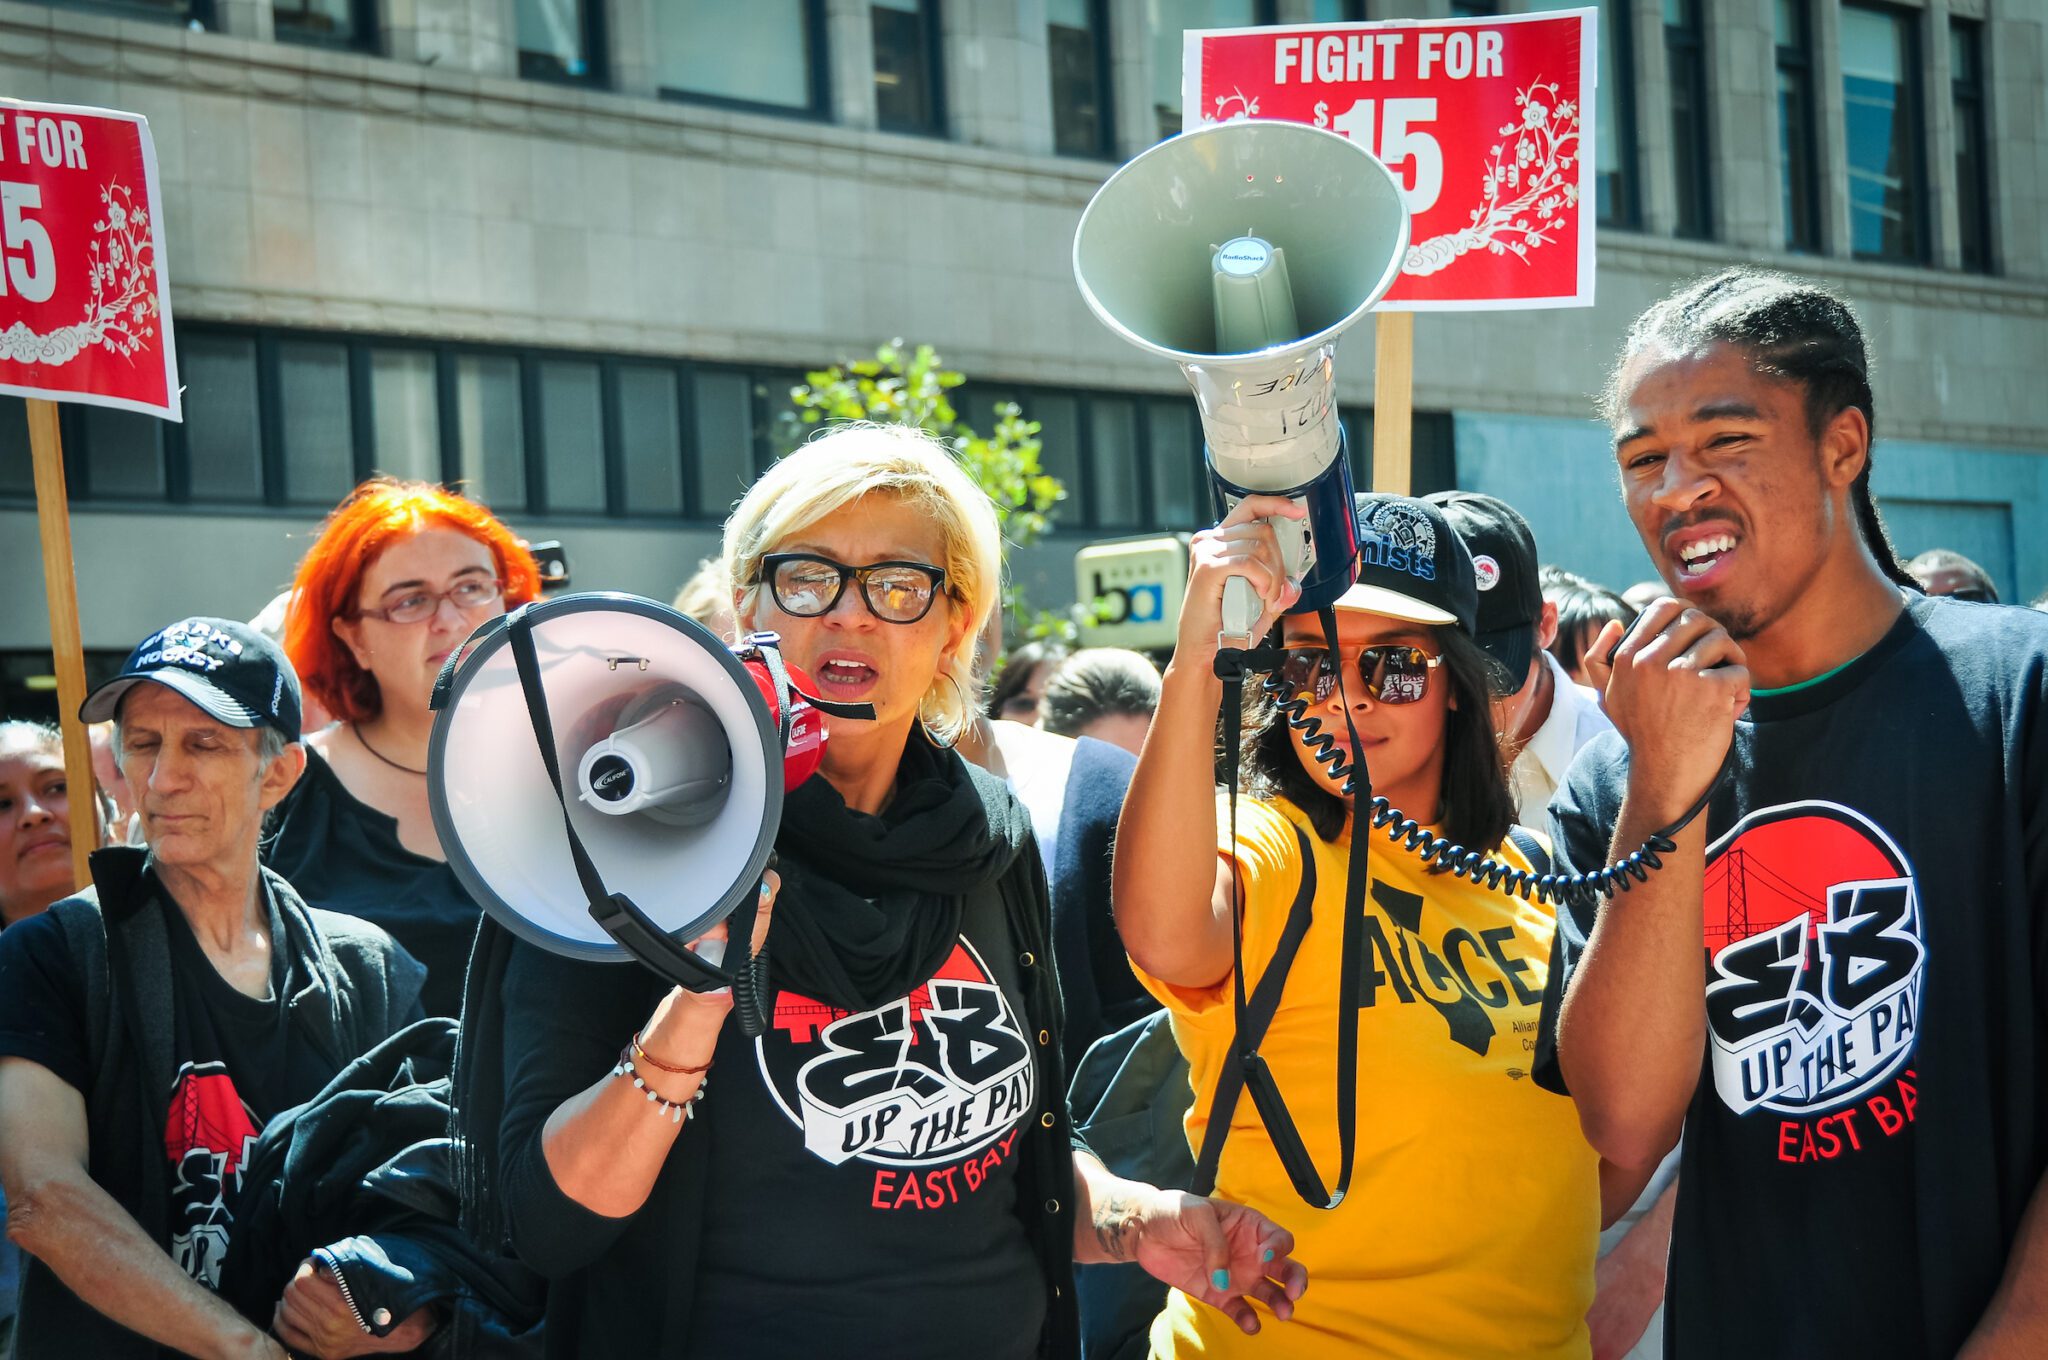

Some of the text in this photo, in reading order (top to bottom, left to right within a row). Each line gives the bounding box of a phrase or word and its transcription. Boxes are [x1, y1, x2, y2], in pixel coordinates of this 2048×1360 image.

[1274, 31, 1504, 85] FIGHT FOR
[15, 115, 88, 171] FOR
[0, 180, 57, 304] 5
[1222, 254, 1265, 262] RadioShack
[1360, 534, 1436, 581] nists
[136, 649, 225, 672] HOCKEY
[1512, 1020, 1539, 1033] Allian
[1522, 1038, 1536, 1051] Co
[1740, 1036, 1792, 1102] UP
[1800, 1018, 1857, 1102] THE
[842, 1066, 1032, 1156] UP THE PAY
[1777, 1069, 1917, 1163] EAST BA
[871, 1129, 1018, 1210] EAST BAY
